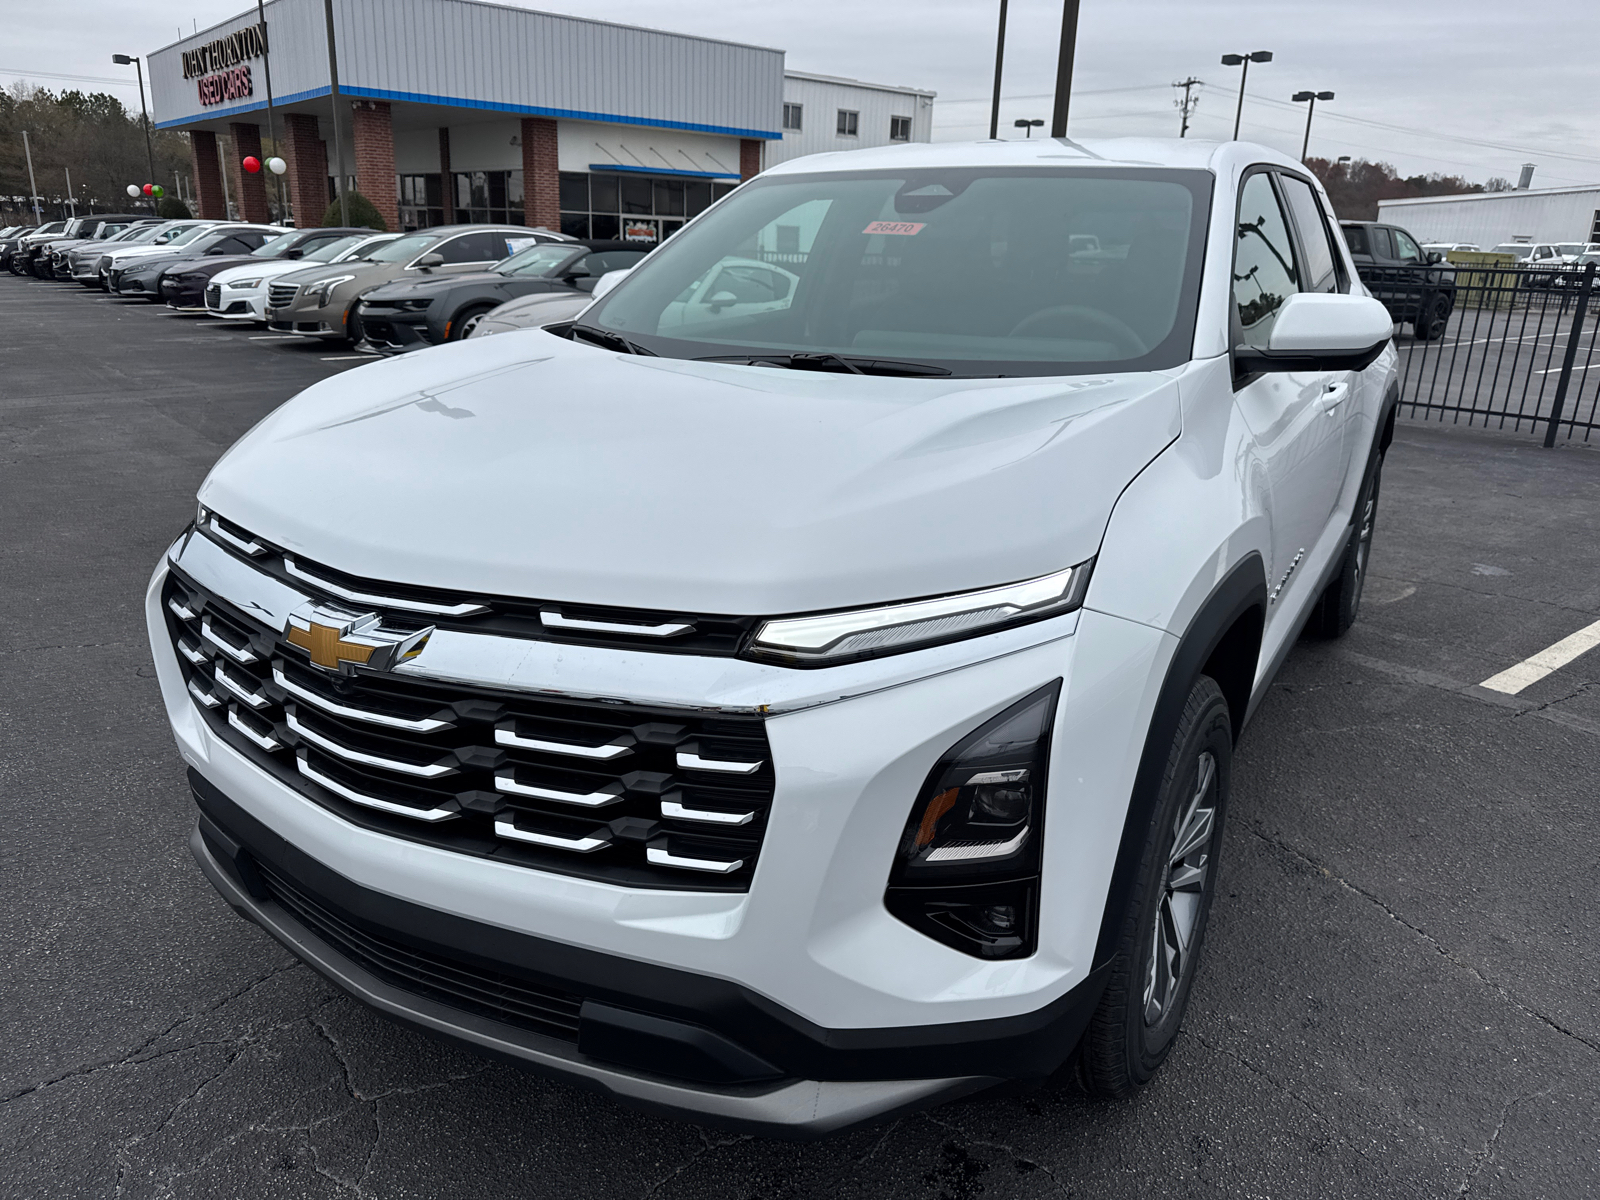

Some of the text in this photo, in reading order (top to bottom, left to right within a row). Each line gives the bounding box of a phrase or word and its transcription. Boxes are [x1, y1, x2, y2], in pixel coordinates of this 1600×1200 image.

[181, 22, 268, 79] JOHN THORNTON
[197, 65, 252, 106] USED CARS
[871, 222, 914, 233] 26470
